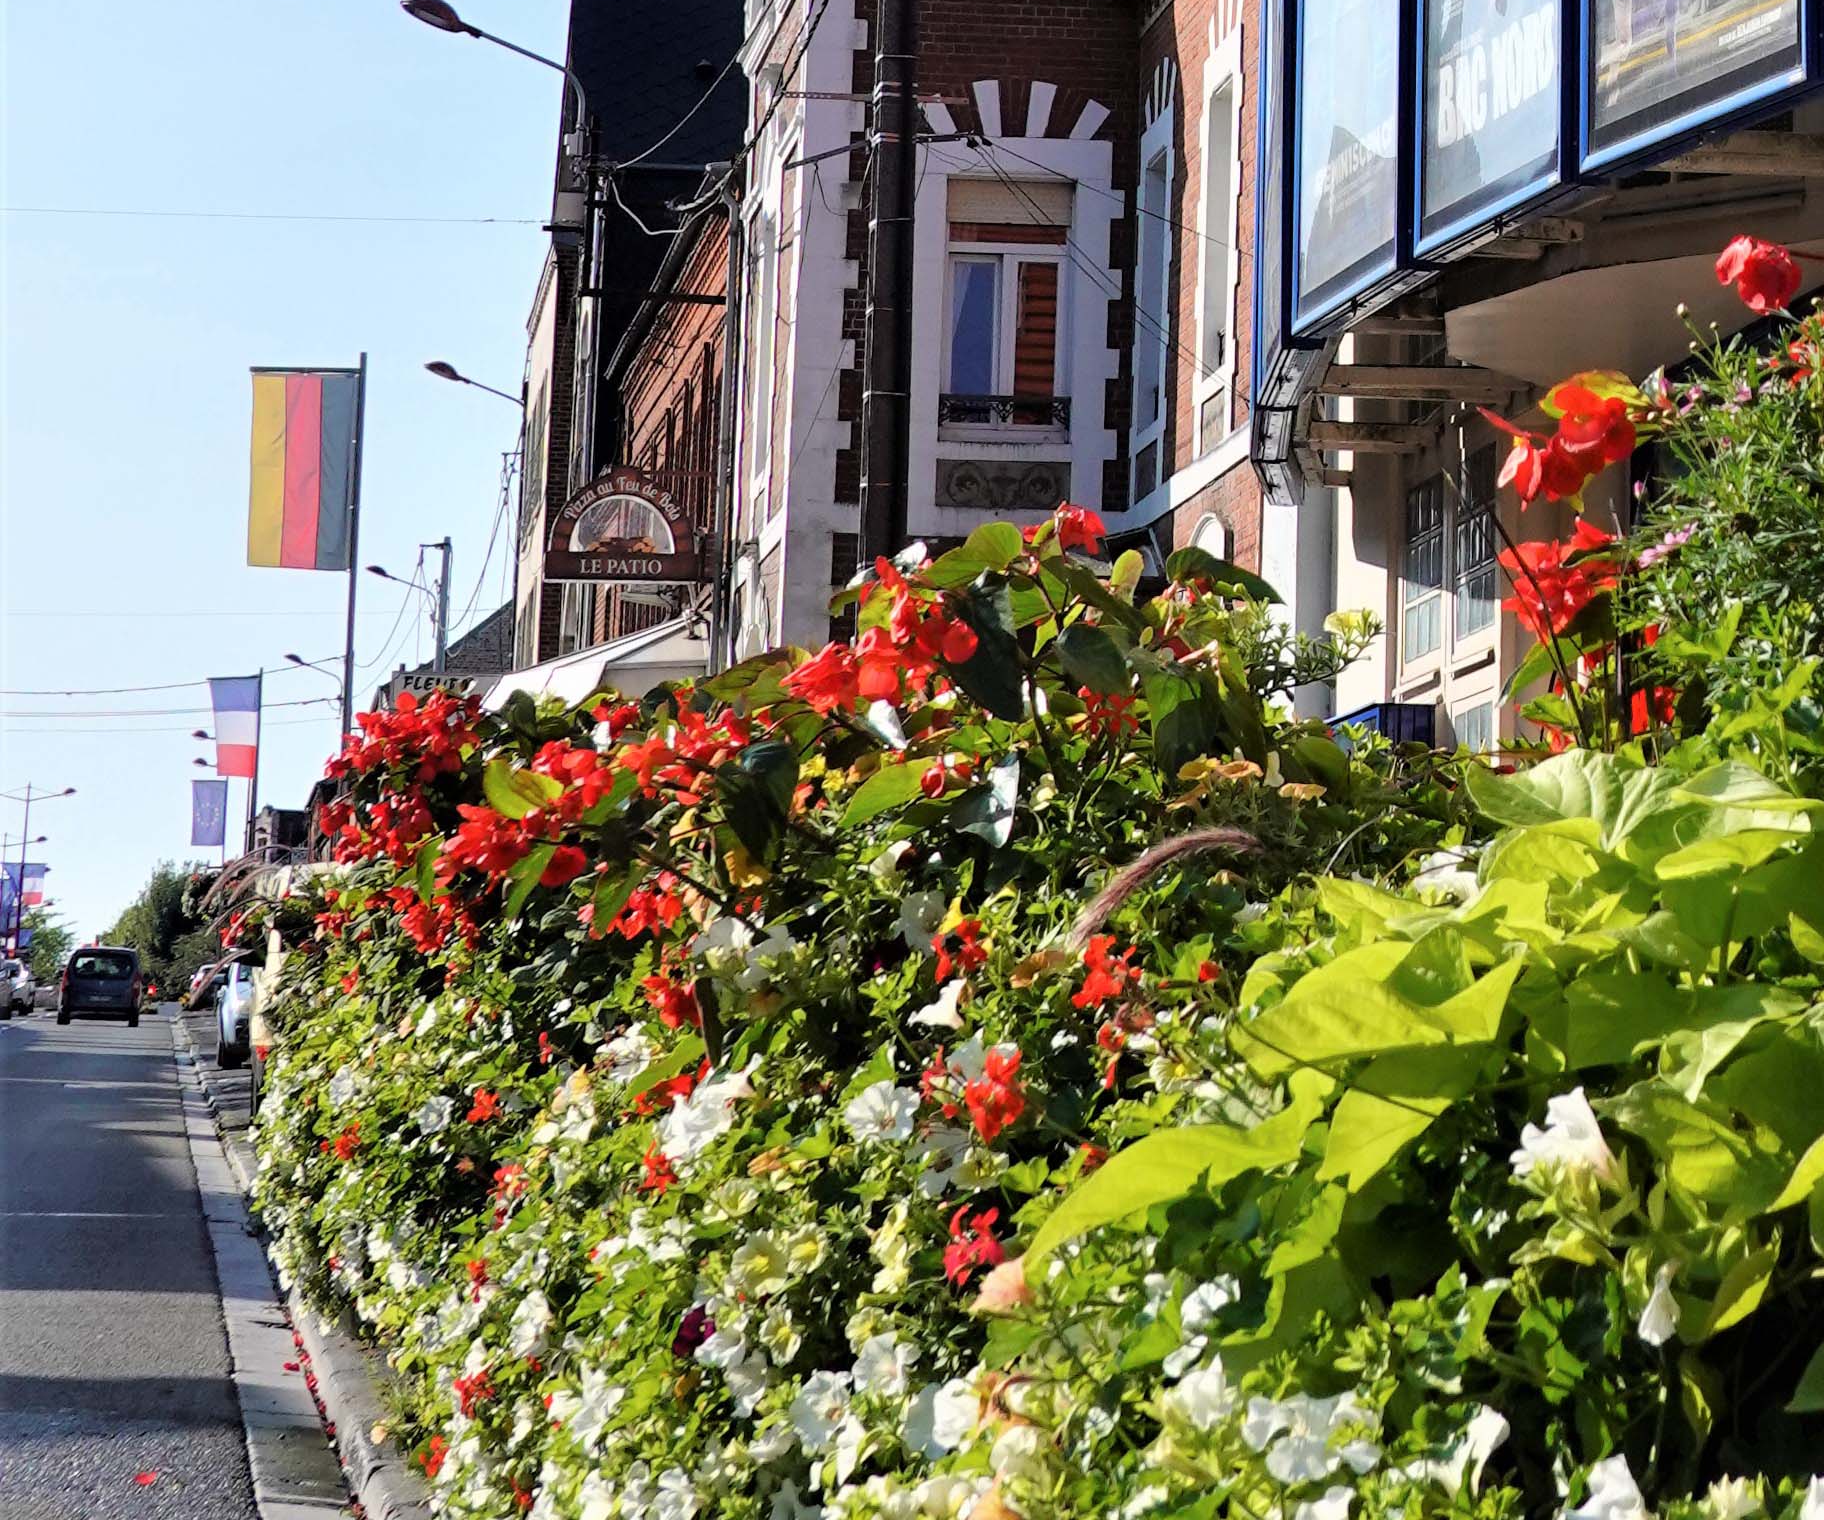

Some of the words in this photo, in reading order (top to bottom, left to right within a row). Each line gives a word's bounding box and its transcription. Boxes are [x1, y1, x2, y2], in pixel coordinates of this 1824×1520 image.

[563, 491, 596, 520] Pizza
[597, 482, 615, 497] au
[616, 476, 640, 493] Feu
[642, 482, 658, 499] de
[658, 491, 681, 521] Bois
[580, 558, 601, 575] LE
[607, 558, 662, 575] PATIO
